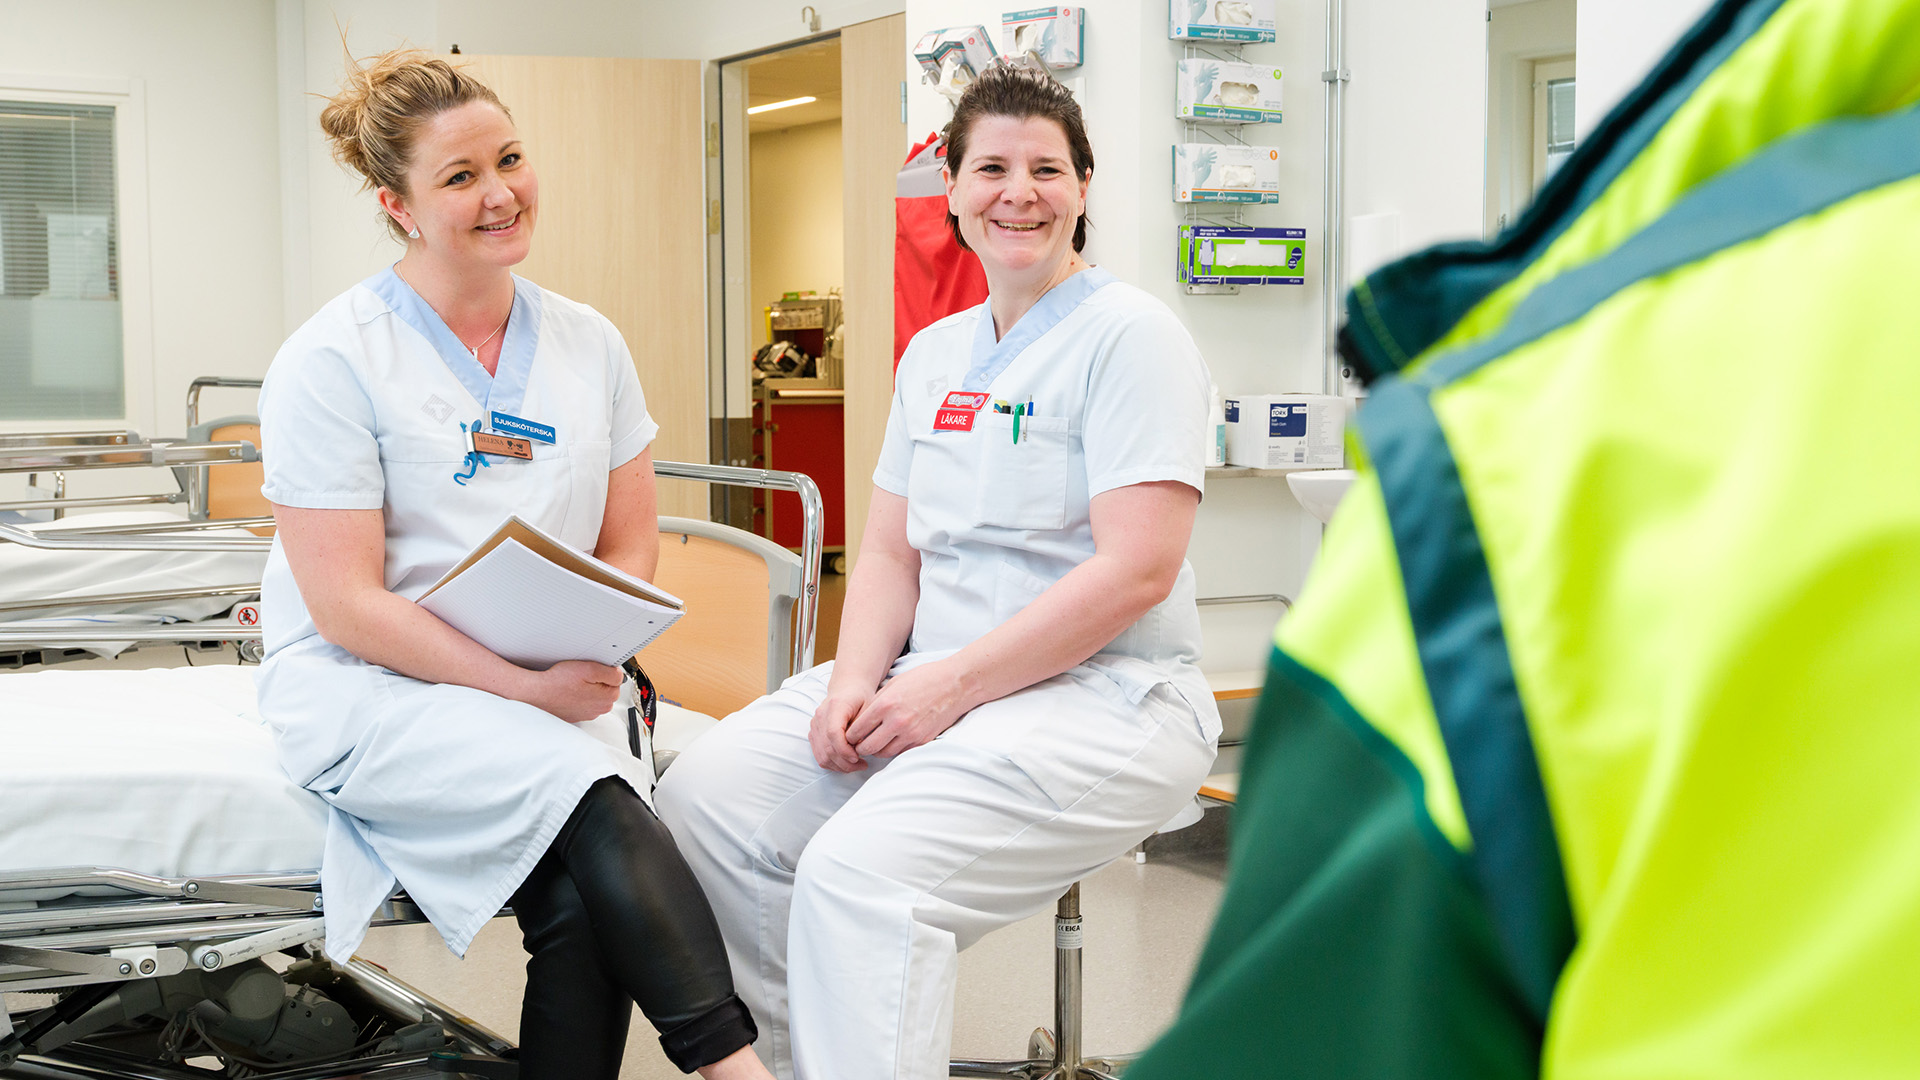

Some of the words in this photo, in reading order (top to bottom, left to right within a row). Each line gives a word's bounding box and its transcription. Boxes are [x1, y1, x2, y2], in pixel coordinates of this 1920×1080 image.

[940, 412, 968, 426] LÄKARE
[494, 417, 553, 438] SJUKSKÖTERSKA
[478, 436, 504, 446] HELENA
